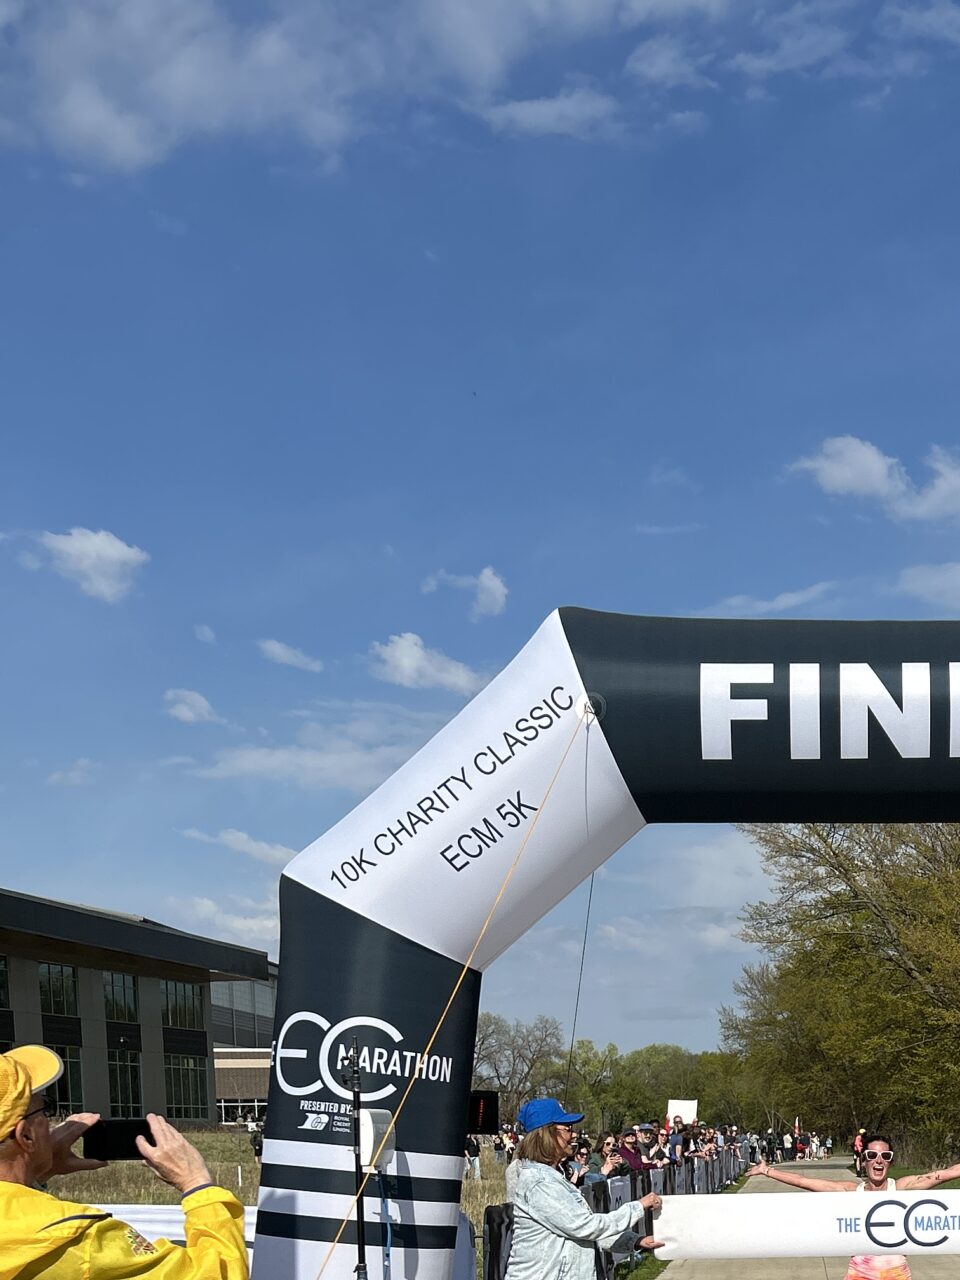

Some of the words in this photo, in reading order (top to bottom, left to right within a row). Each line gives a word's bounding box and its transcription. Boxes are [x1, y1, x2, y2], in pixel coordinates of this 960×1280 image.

[330, 848, 378, 890] 10K
[373, 767, 475, 858] CHARITY
[473, 685, 575, 776] CLASSIC
[439, 817, 505, 873] ECM
[500, 790, 539, 829] 5K
[336, 1043, 453, 1083] MARATHON
[299, 1100, 339, 1113] PRESENTED
[837, 1217, 861, 1233] THE
[865, 1199, 949, 1248] EC
